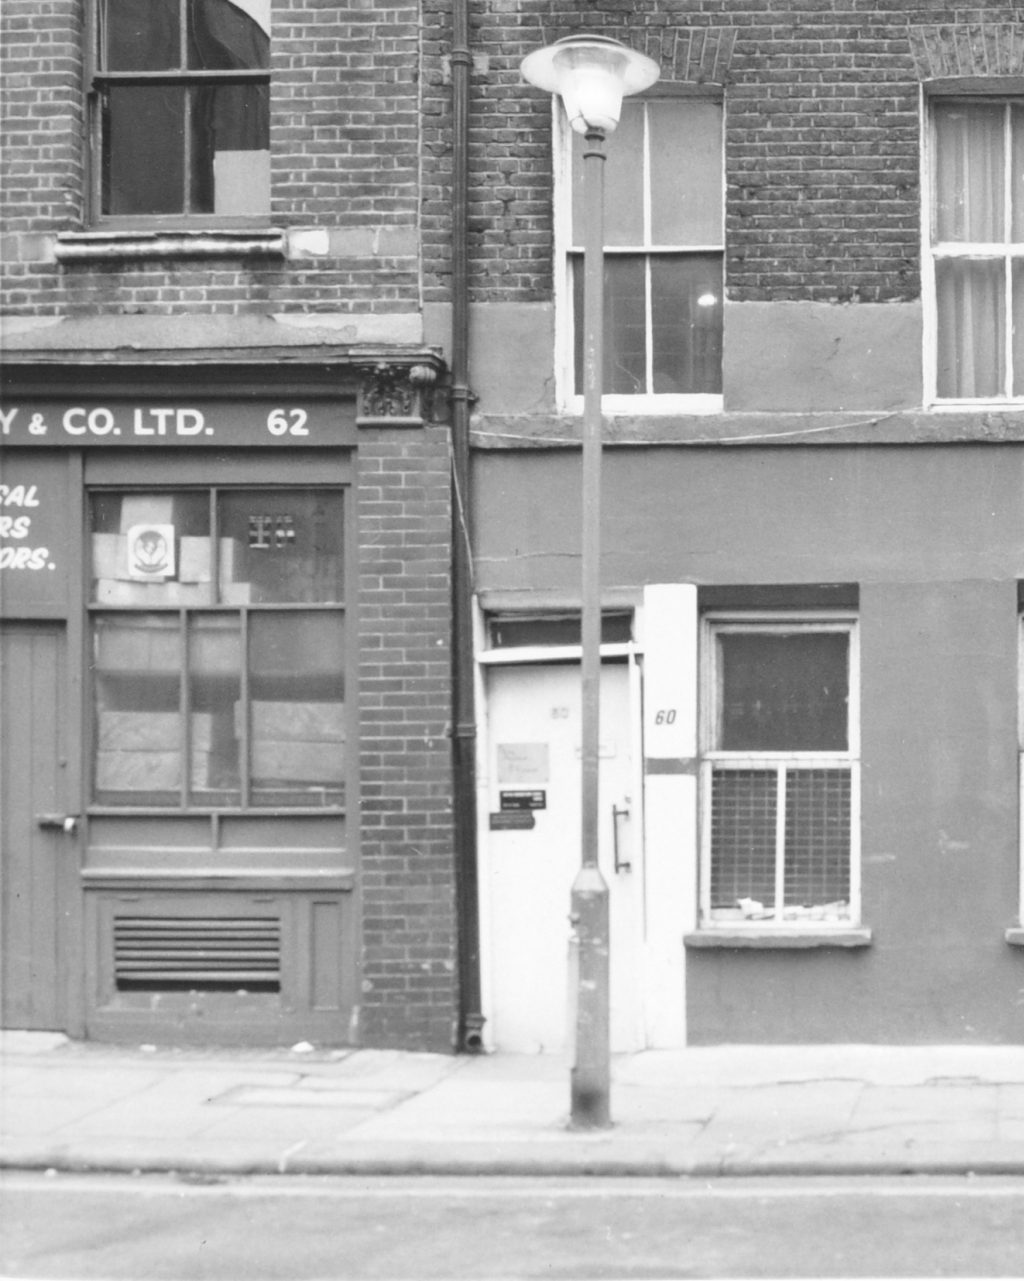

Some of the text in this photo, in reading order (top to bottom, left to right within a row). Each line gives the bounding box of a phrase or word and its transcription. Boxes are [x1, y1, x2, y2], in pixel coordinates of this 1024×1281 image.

[28, 413, 48, 435] &
[62, 407, 122, 436] CO.
[133, 407, 215, 436] LTD.
[266, 408, 310, 436] 62
[654, 708, 678, 726] 60
